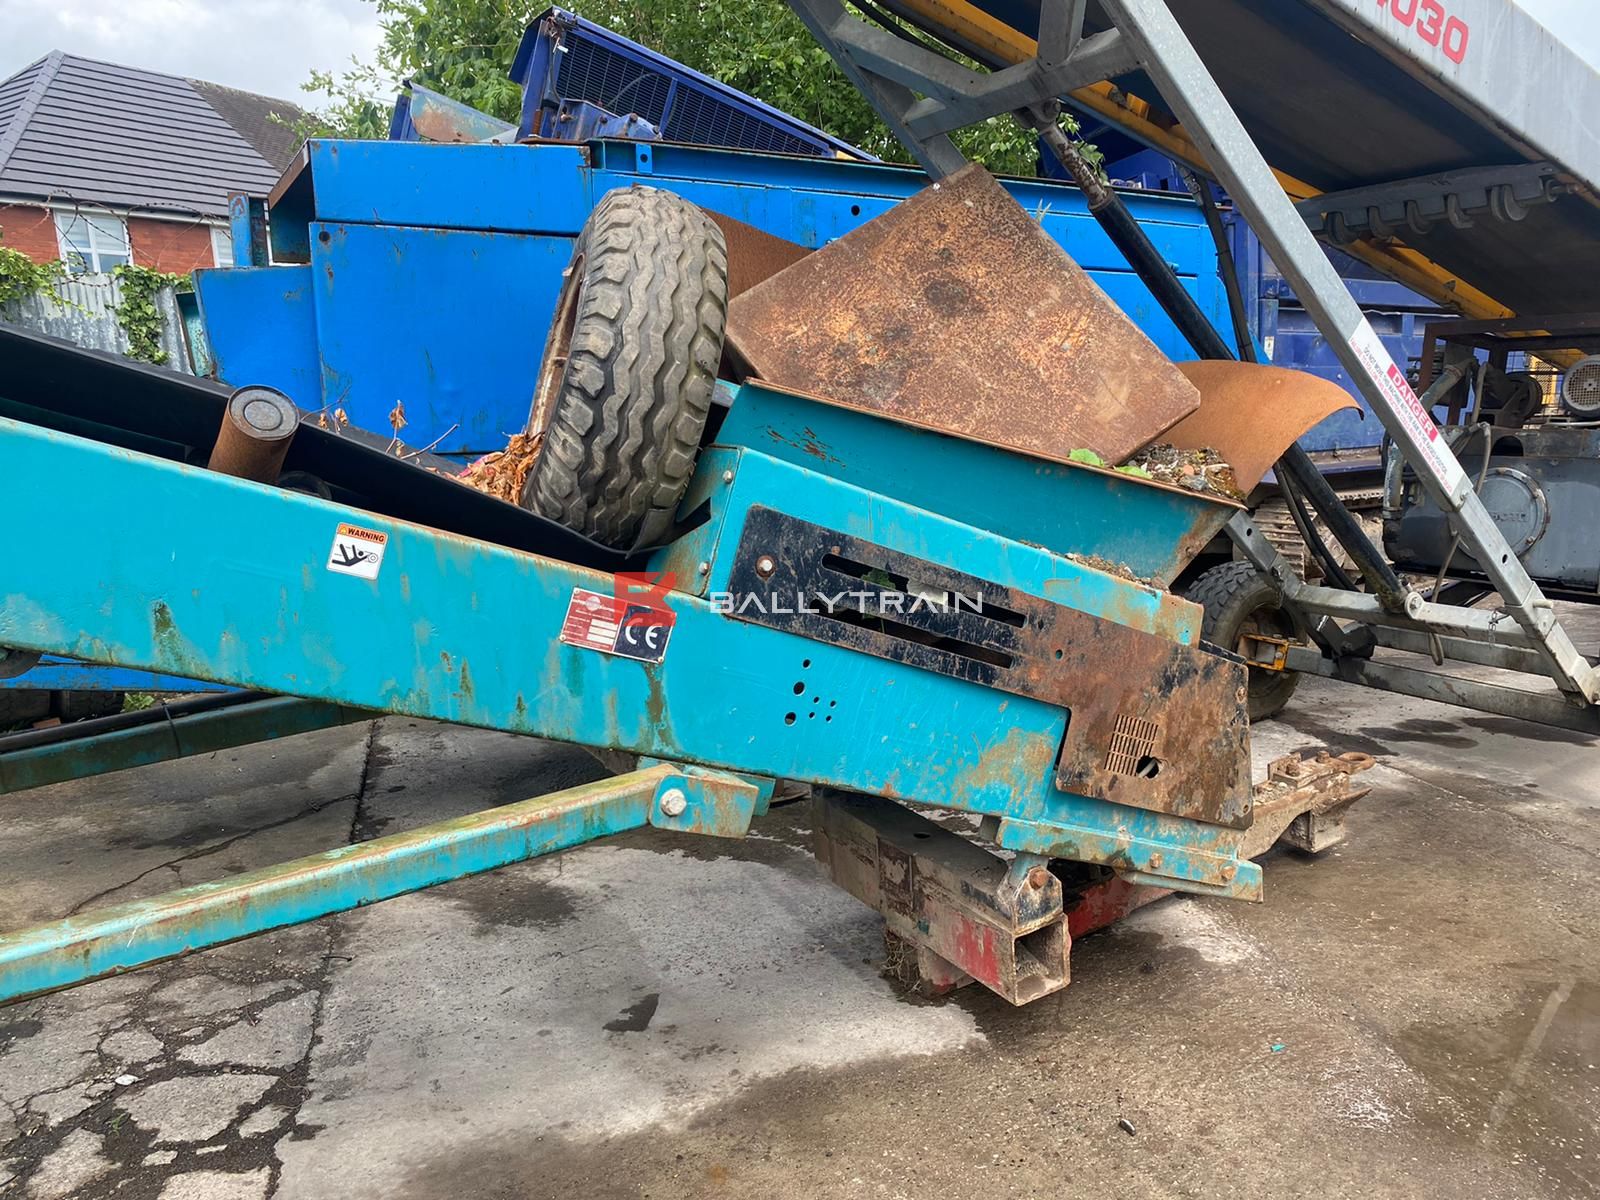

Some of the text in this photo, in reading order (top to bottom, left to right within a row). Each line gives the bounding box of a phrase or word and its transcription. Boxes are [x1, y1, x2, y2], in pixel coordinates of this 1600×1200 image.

[1376, 0, 1469, 64] 030
[1392, 372, 1433, 436] DANGER
[348, 528, 385, 542] WARNING
[625, 617, 663, 650] CE
